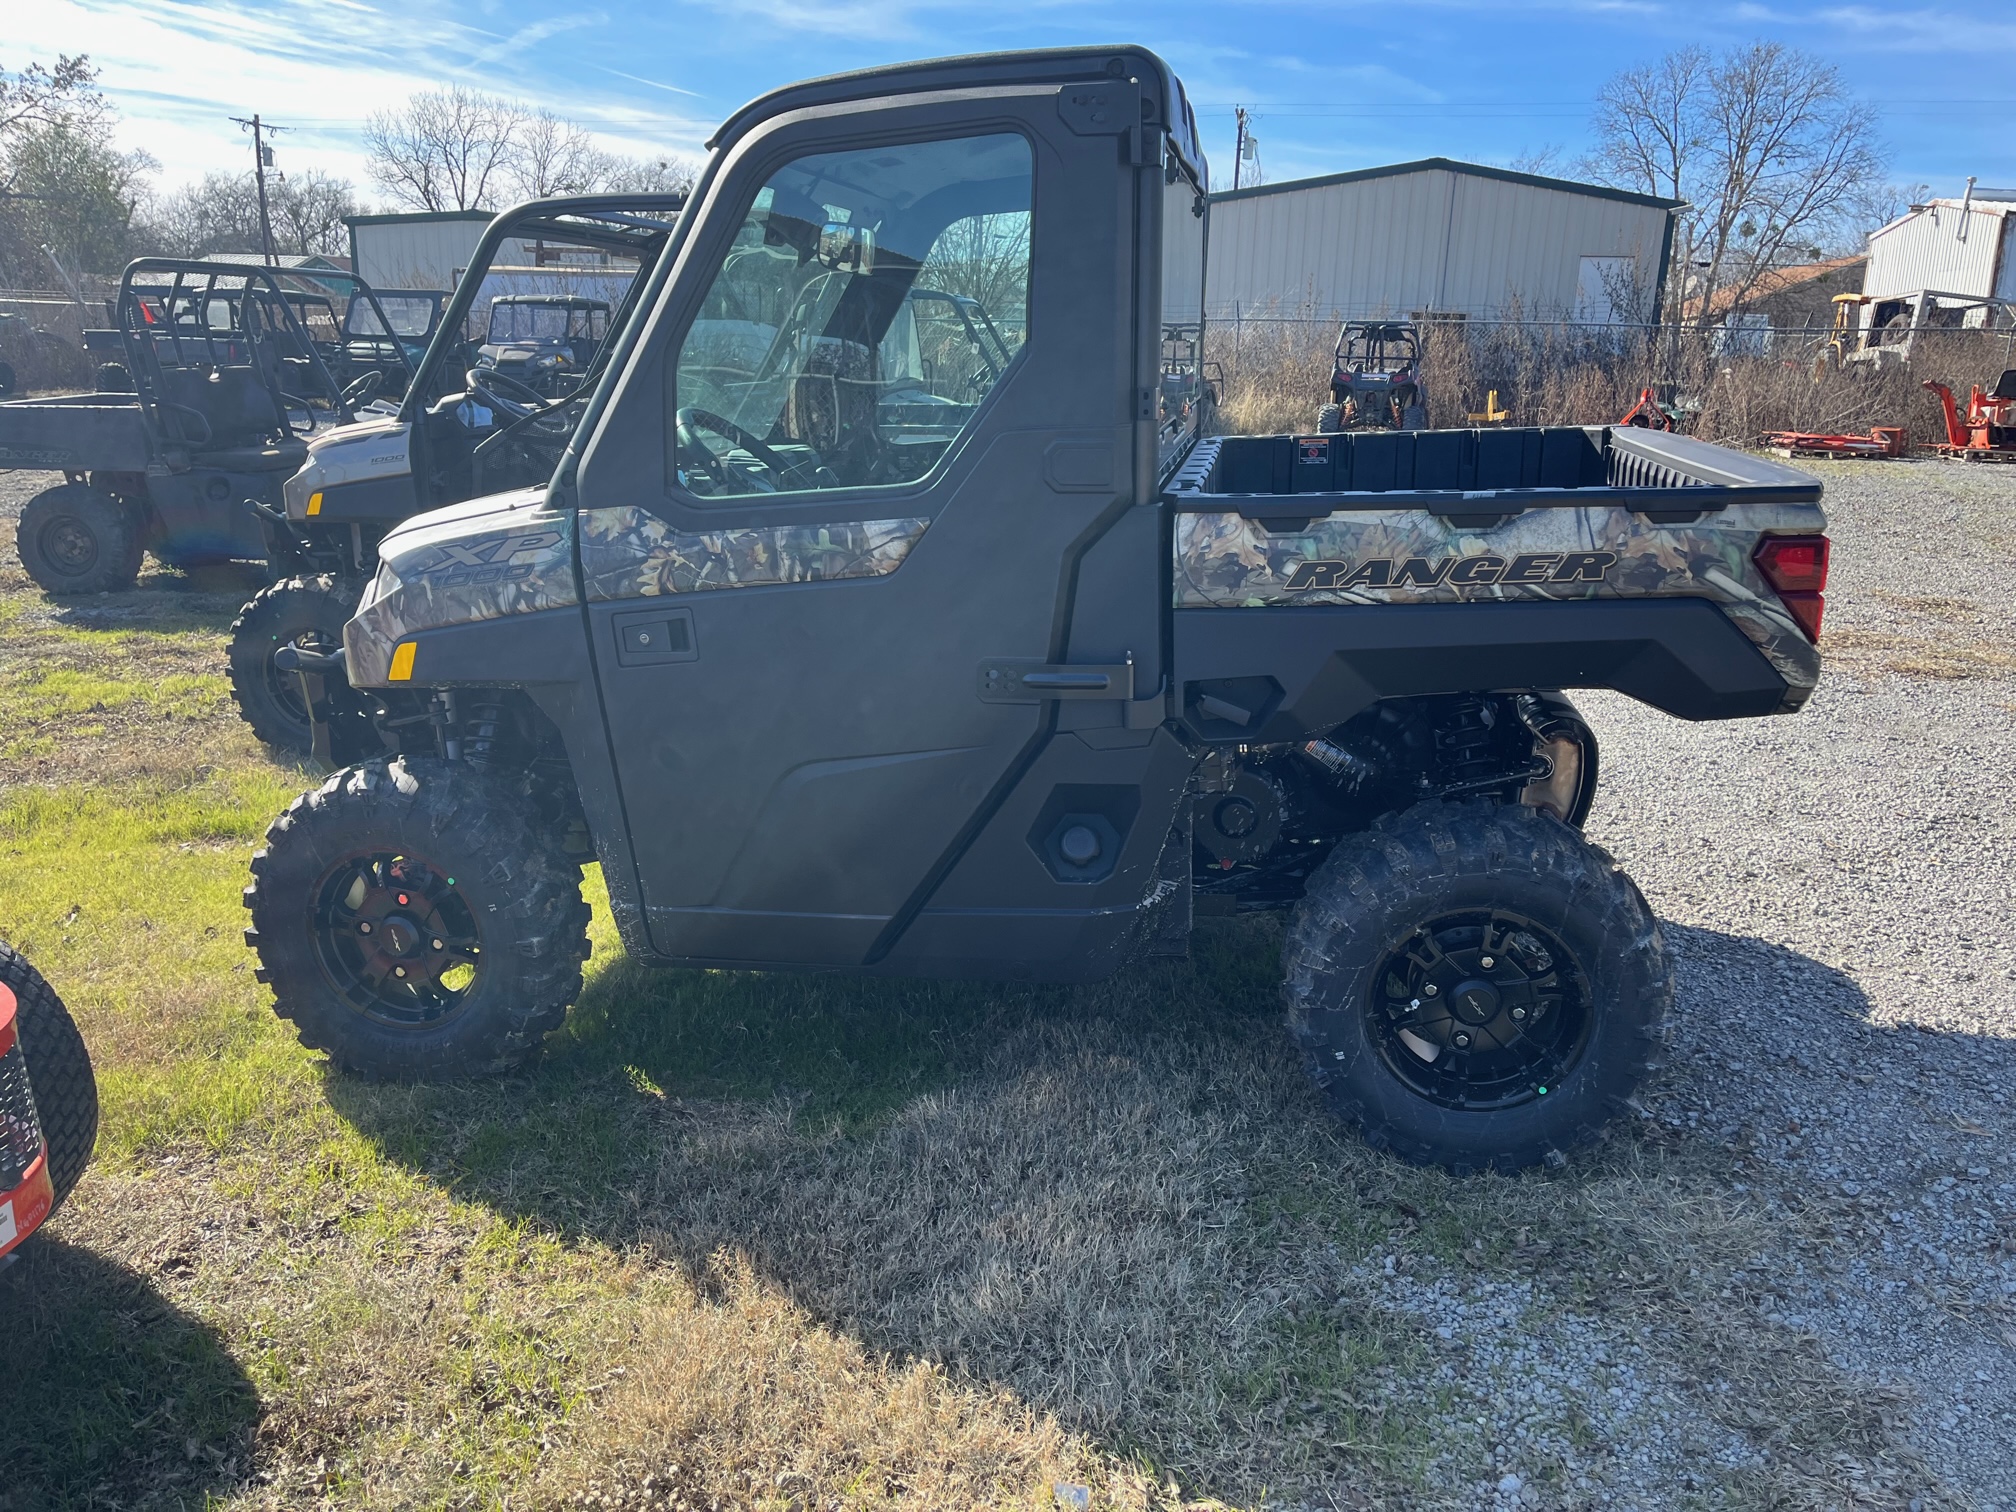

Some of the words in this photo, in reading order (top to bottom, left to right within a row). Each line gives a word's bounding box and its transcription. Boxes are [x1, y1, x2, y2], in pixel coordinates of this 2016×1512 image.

[371, 454, 406, 463] 1000
[422, 531, 564, 574] XP
[431, 563, 536, 590] 1000
[1282, 551, 1618, 591] RANGER
